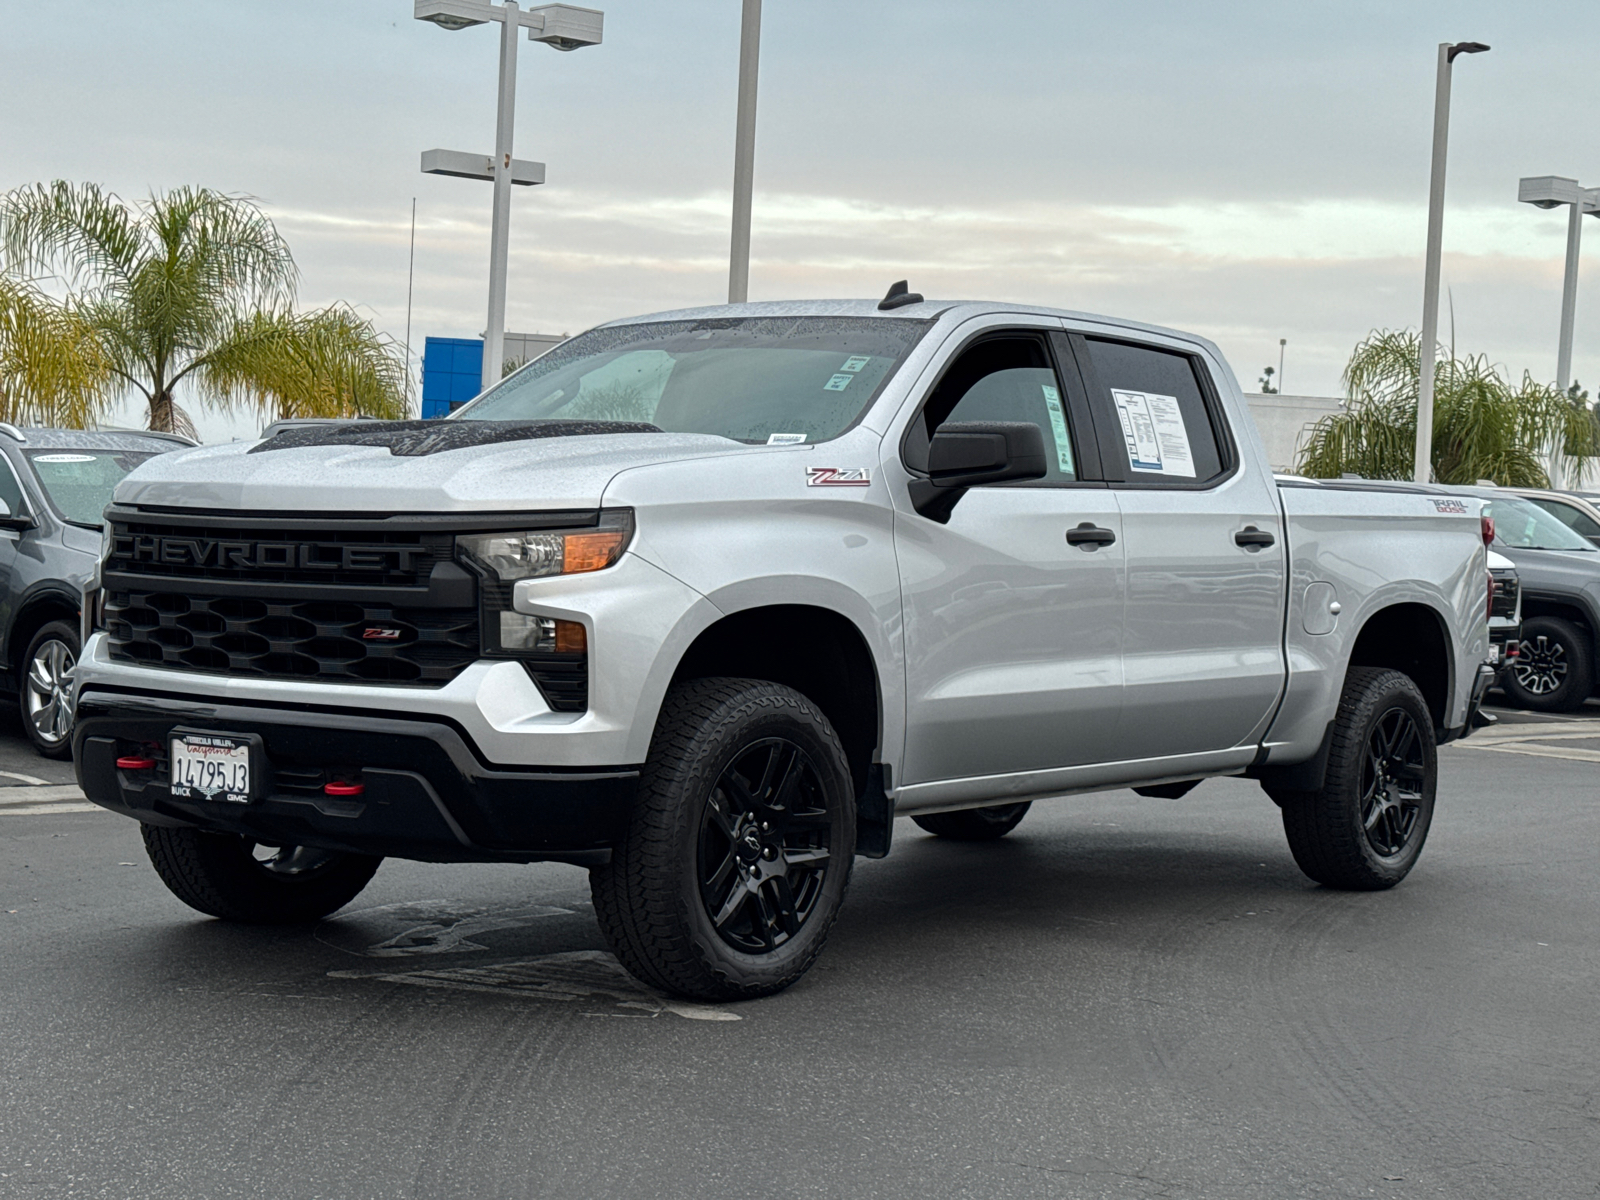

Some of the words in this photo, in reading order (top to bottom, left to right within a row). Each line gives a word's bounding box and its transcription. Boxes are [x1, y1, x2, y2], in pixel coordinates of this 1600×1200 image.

[805, 466, 872, 487] Z71
[1426, 498, 1469, 508] TRAIL
[111, 536, 427, 571] CHEVROLET
[362, 628, 401, 639] Z71
[186, 735, 212, 745] TEMECULA
[212, 738, 232, 747] VALLEY
[175, 757, 247, 793] 14795J3
[171, 786, 191, 797] BUICK
[227, 794, 248, 803] GMC
